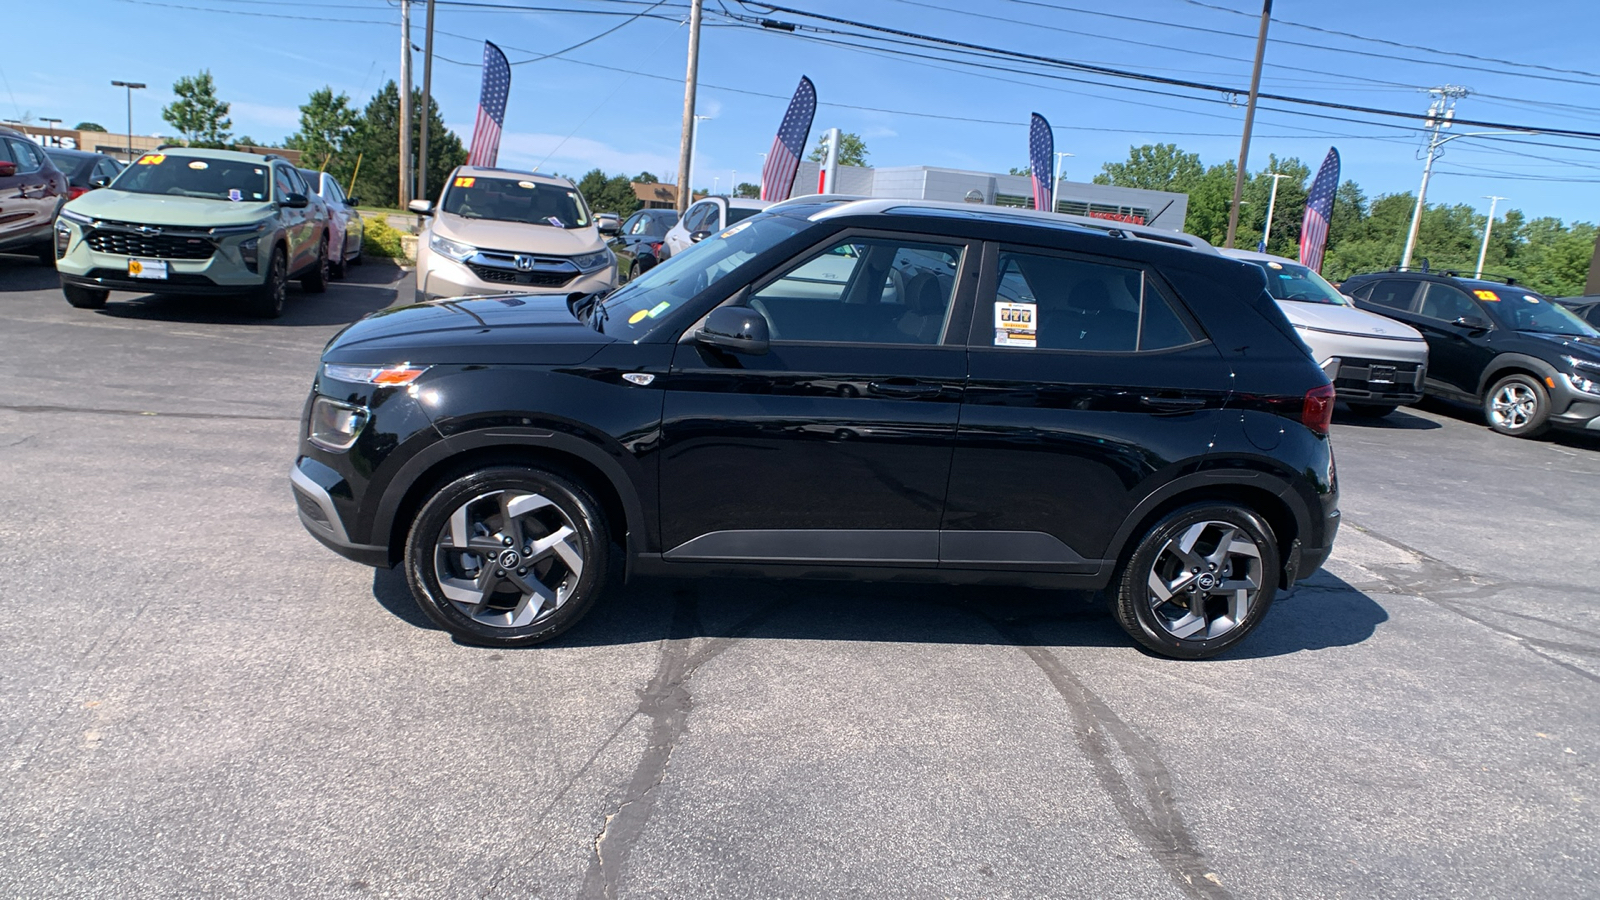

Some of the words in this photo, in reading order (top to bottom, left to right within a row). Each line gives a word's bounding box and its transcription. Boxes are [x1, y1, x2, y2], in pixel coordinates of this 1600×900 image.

[26, 134, 77, 149] HL'S
[454, 178, 475, 188] 17
[1473, 290, 1500, 301] 23
